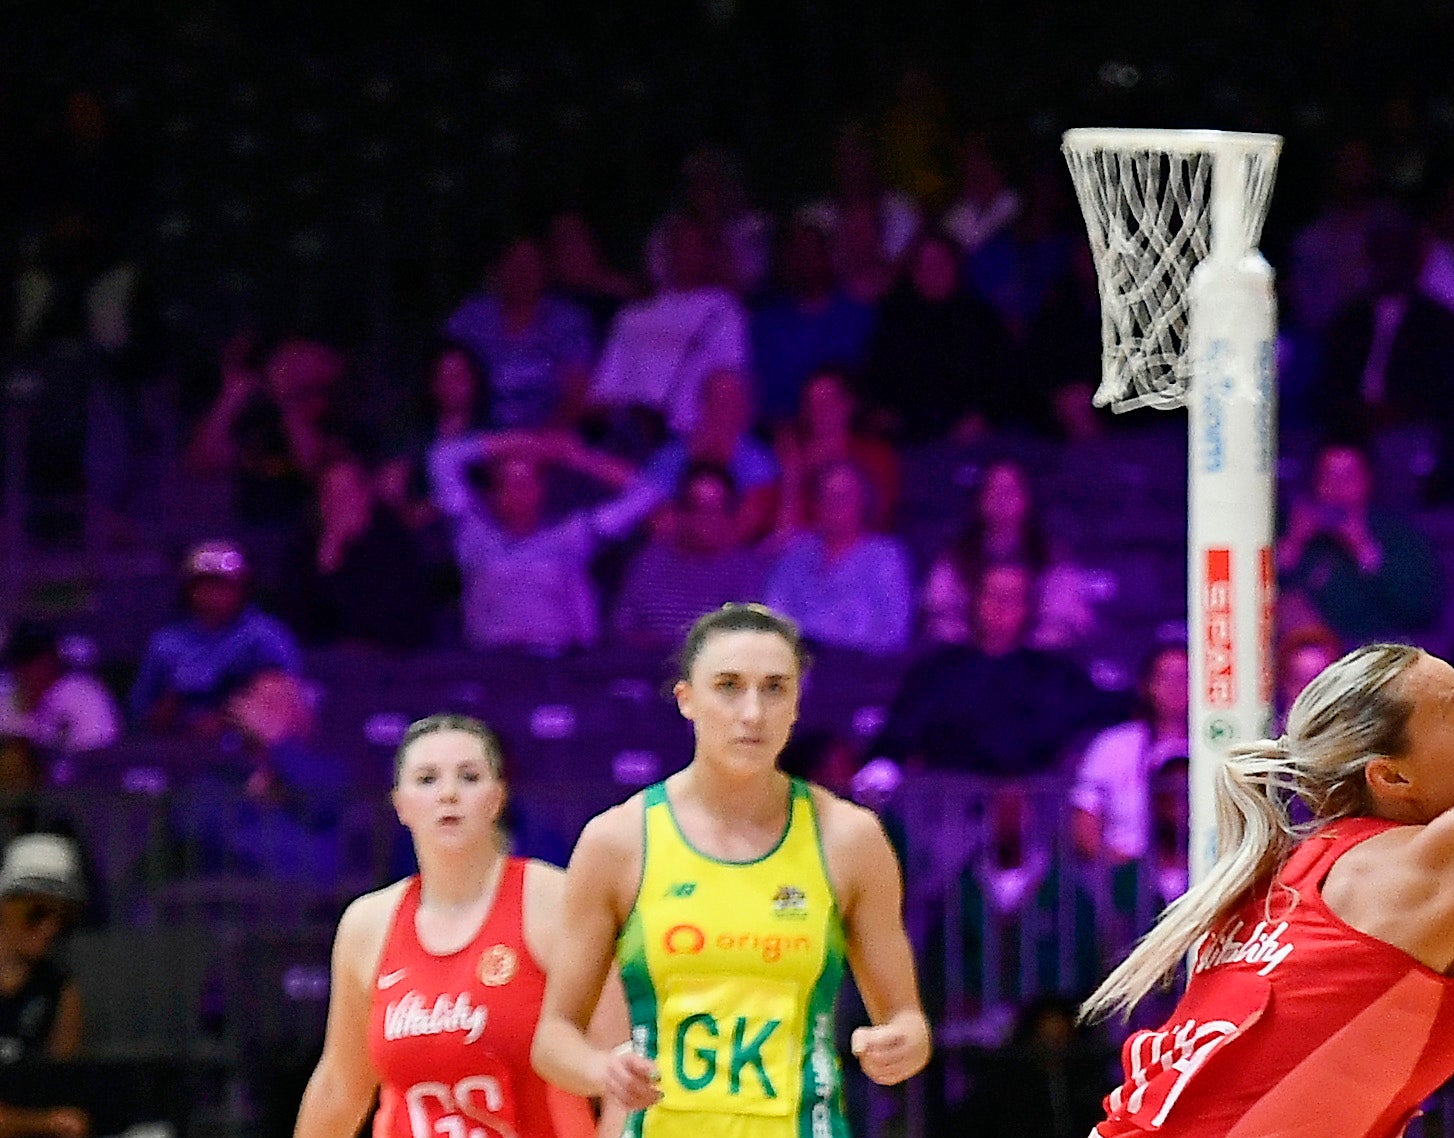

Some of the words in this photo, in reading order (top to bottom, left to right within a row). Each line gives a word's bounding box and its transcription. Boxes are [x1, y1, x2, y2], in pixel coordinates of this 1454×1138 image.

[715, 932, 811, 963] origin
[384, 990, 489, 1045] Vitality
[674, 1012, 782, 1099] GK
